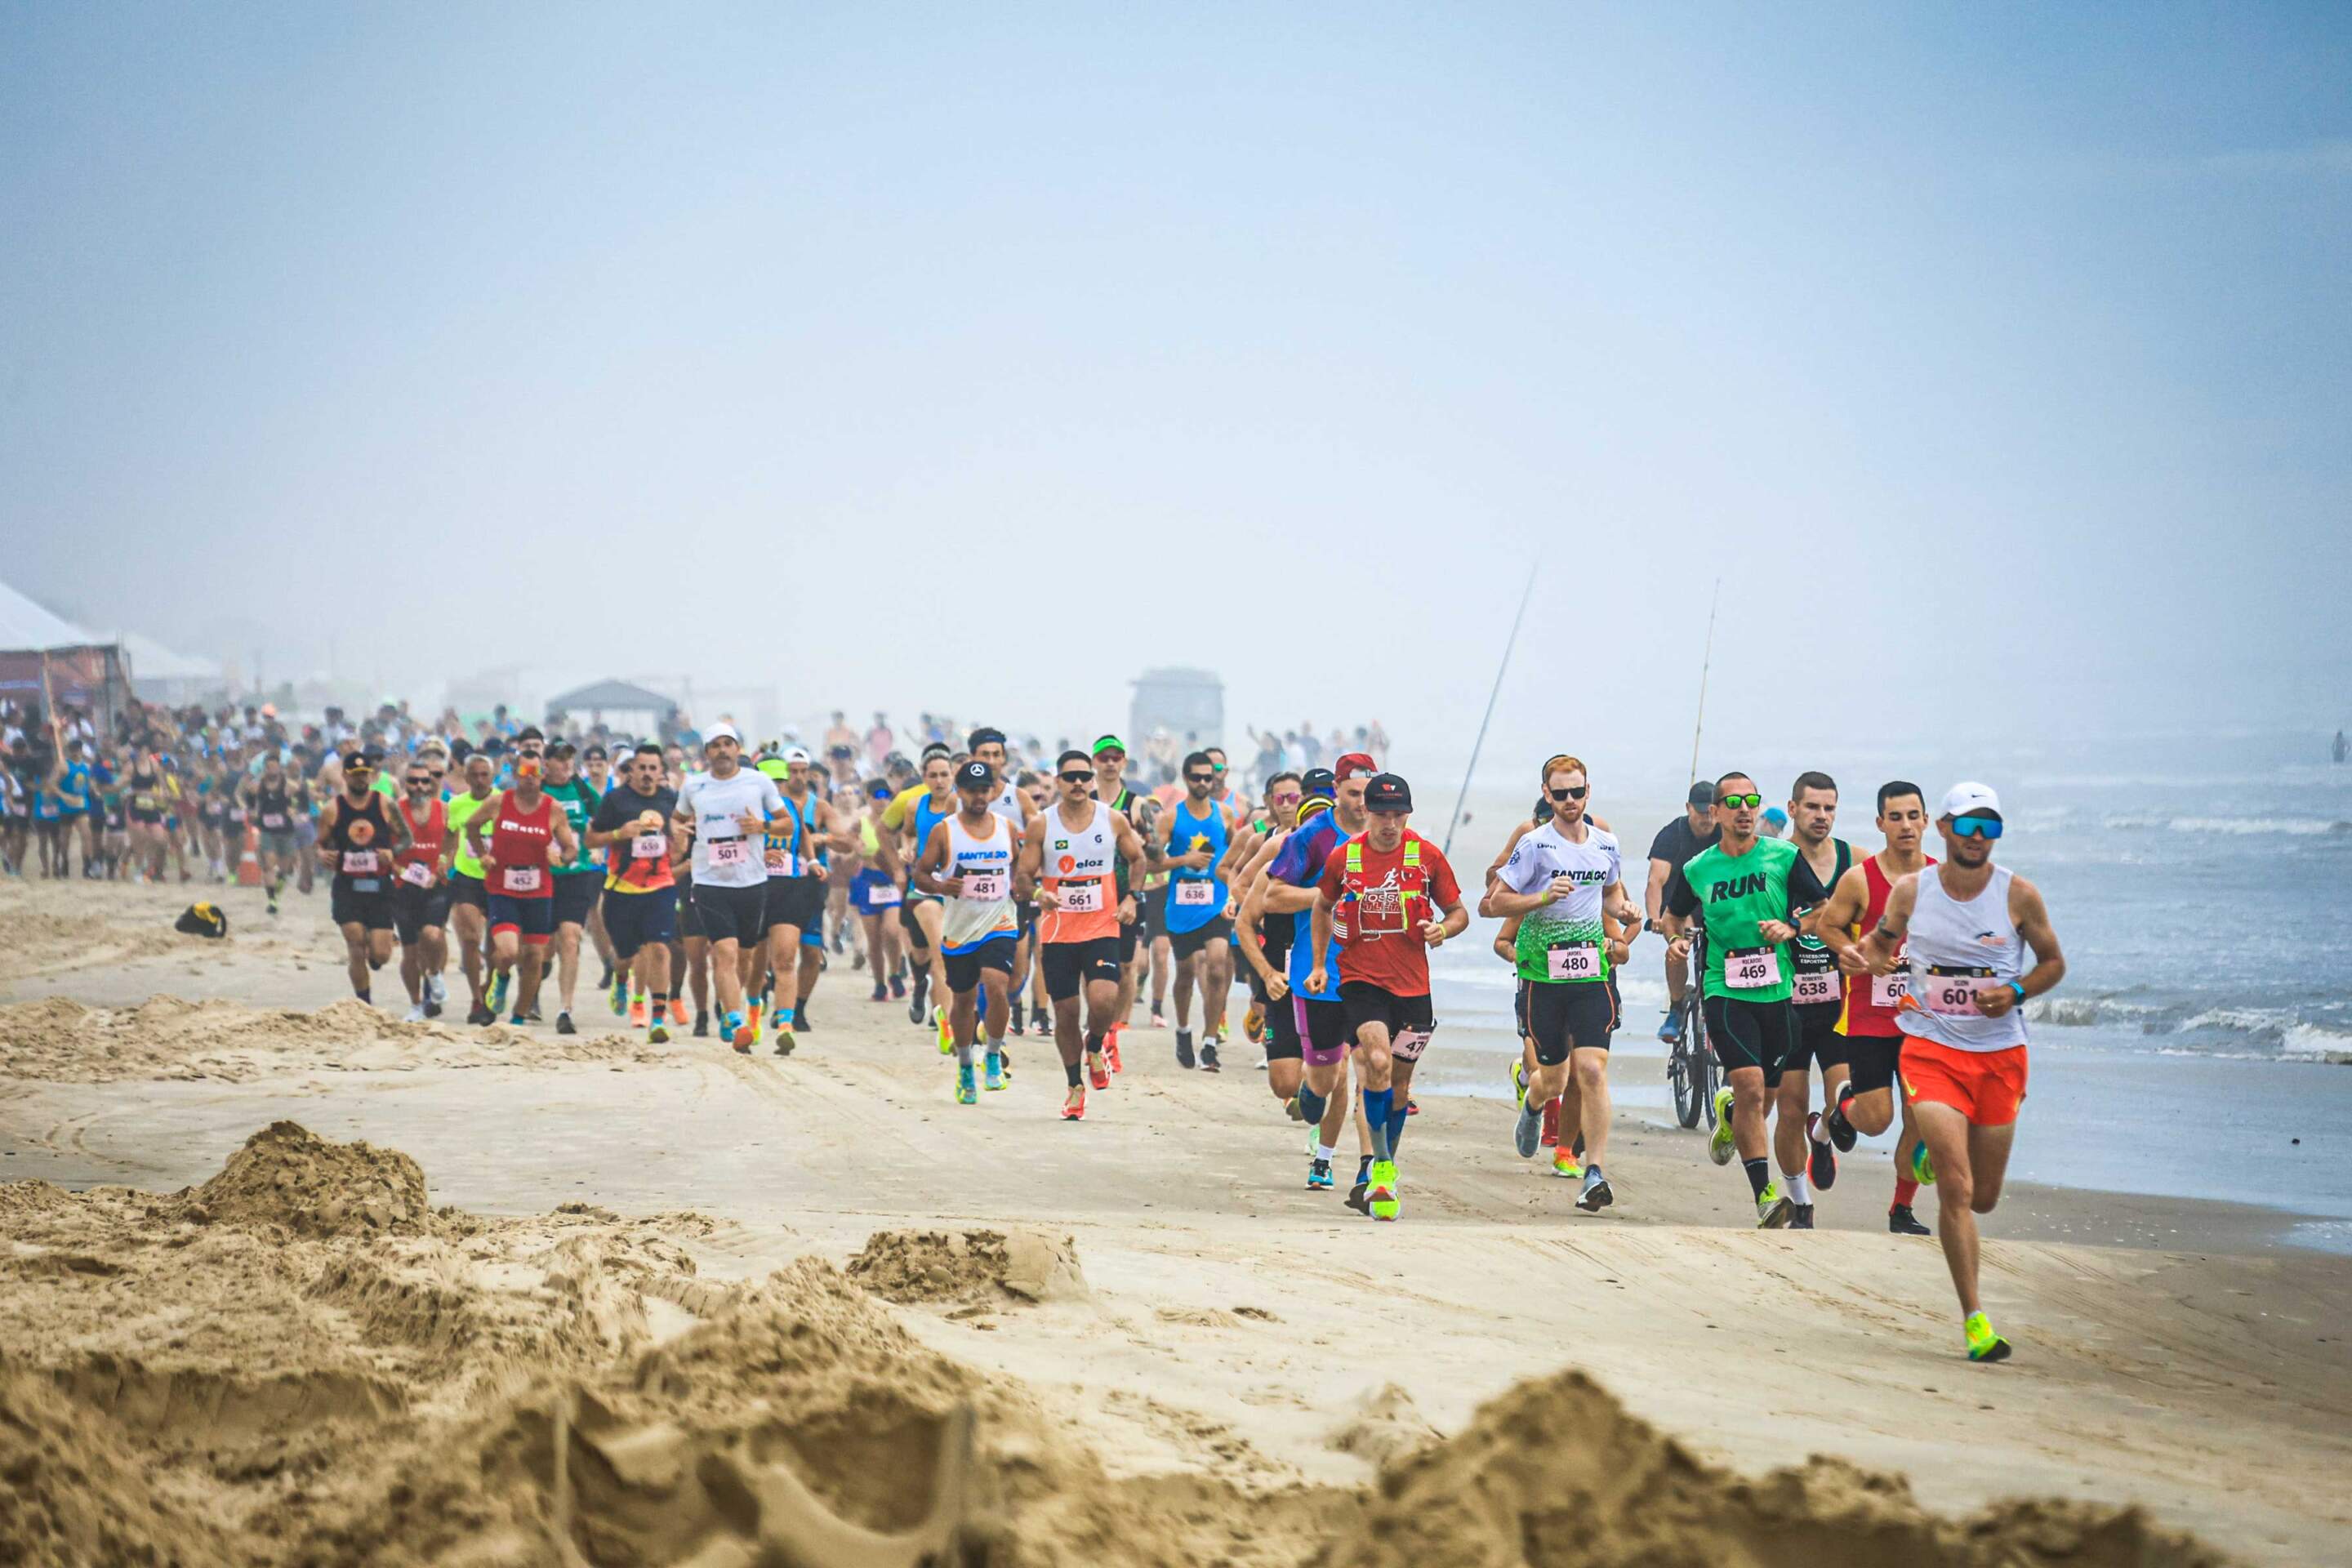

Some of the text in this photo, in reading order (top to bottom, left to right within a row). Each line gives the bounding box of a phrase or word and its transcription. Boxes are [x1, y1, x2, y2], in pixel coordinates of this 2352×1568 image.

[1094, 835, 1102, 844] G
[718, 848, 738, 860] 501
[1551, 869, 1607, 881] SANTIAGO
[973, 883, 996, 893] 481
[1185, 889, 1205, 899] 636
[1069, 894, 1091, 906] 661
[1561, 956, 1588, 971] 480
[1740, 964, 1766, 980] 469
[1799, 982, 1828, 996] 638
[1942, 988, 1978, 1005] 601
